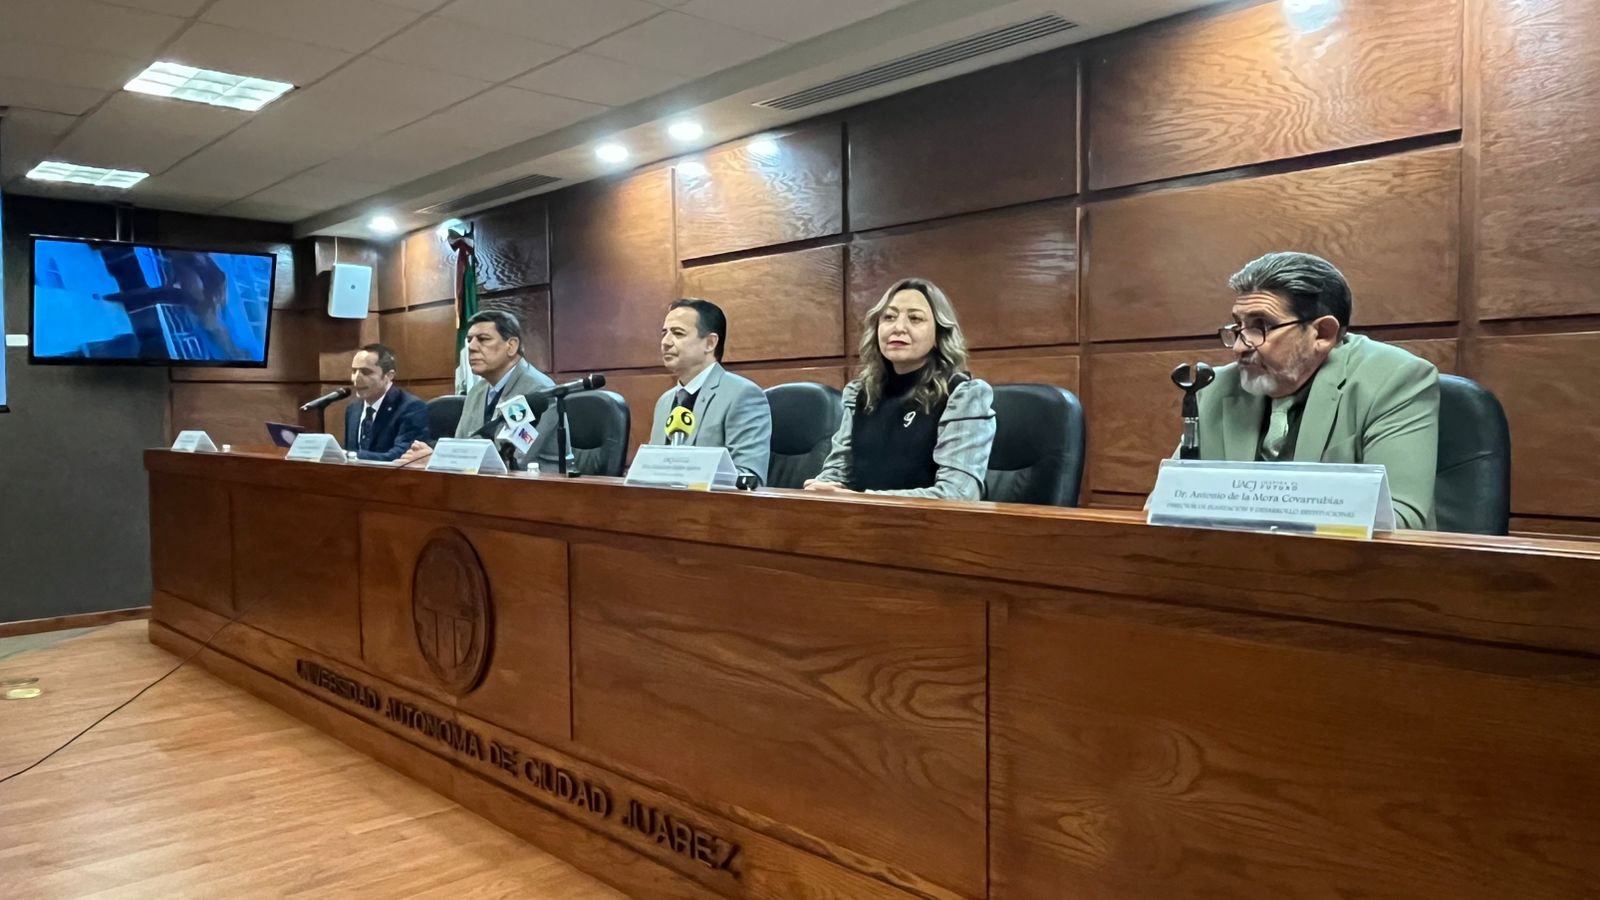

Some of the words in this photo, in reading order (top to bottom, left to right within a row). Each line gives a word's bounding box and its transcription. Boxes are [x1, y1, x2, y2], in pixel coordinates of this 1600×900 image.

[681, 411, 693, 426] 6
[1232, 480, 1257, 492] UACJ
[1174, 489, 1187, 498] Dr.
[1189, 490, 1226, 500] Antonio
[1227, 492, 1240, 500] de
[1242, 492, 1250, 501] la
[1252, 493, 1279, 503] Mora
[1281, 494, 1344, 505] Covarrubias
[385, 697, 485, 761] AUTONOMA
[488, 739, 519, 777] DE
[523, 756, 614, 819] CIUDAD
[621, 798, 743, 879] JUAREZ
